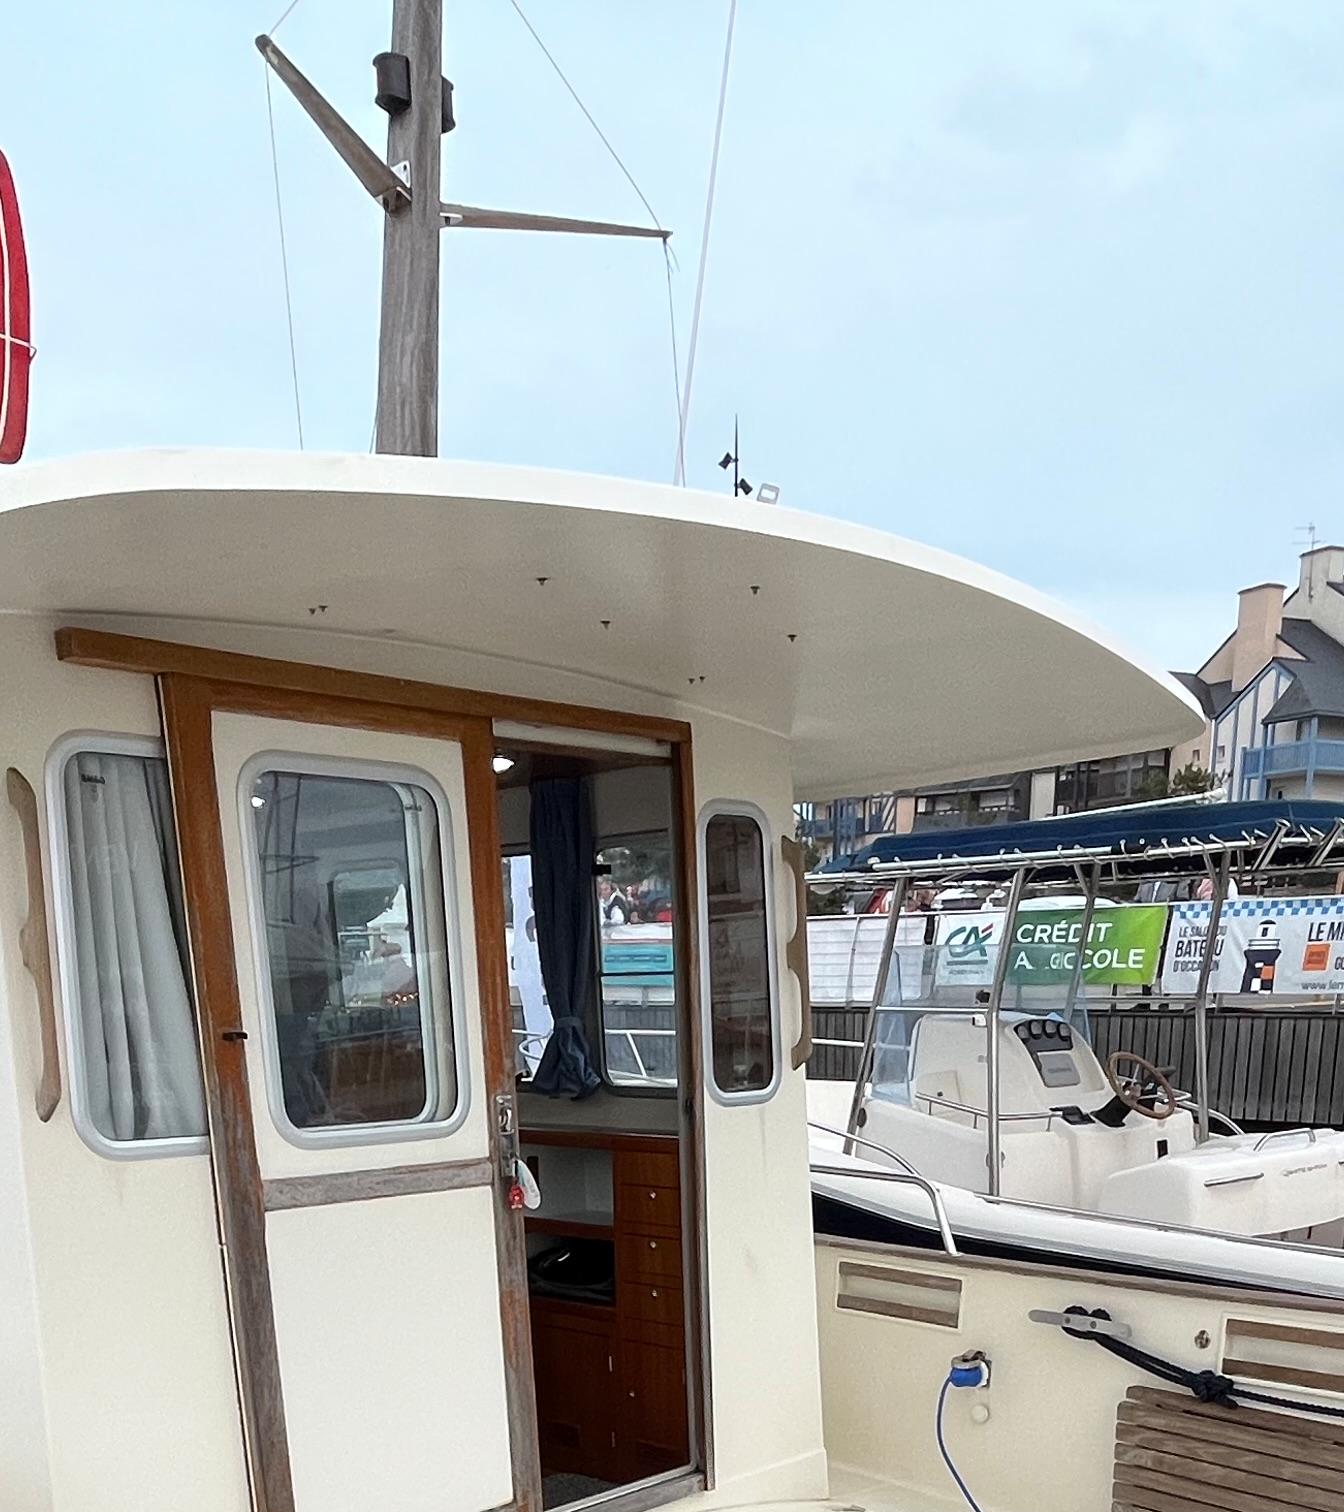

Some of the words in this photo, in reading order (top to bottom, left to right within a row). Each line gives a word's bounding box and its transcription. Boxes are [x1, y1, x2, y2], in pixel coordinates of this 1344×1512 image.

[1016, 920, 1113, 943] CRÉDIT
[1179, 926, 1189, 938] LE
[1190, 926, 1210, 938] SALO
[1308, 921, 1326, 941] LE
[1175, 939, 1225, 958] BATEU
